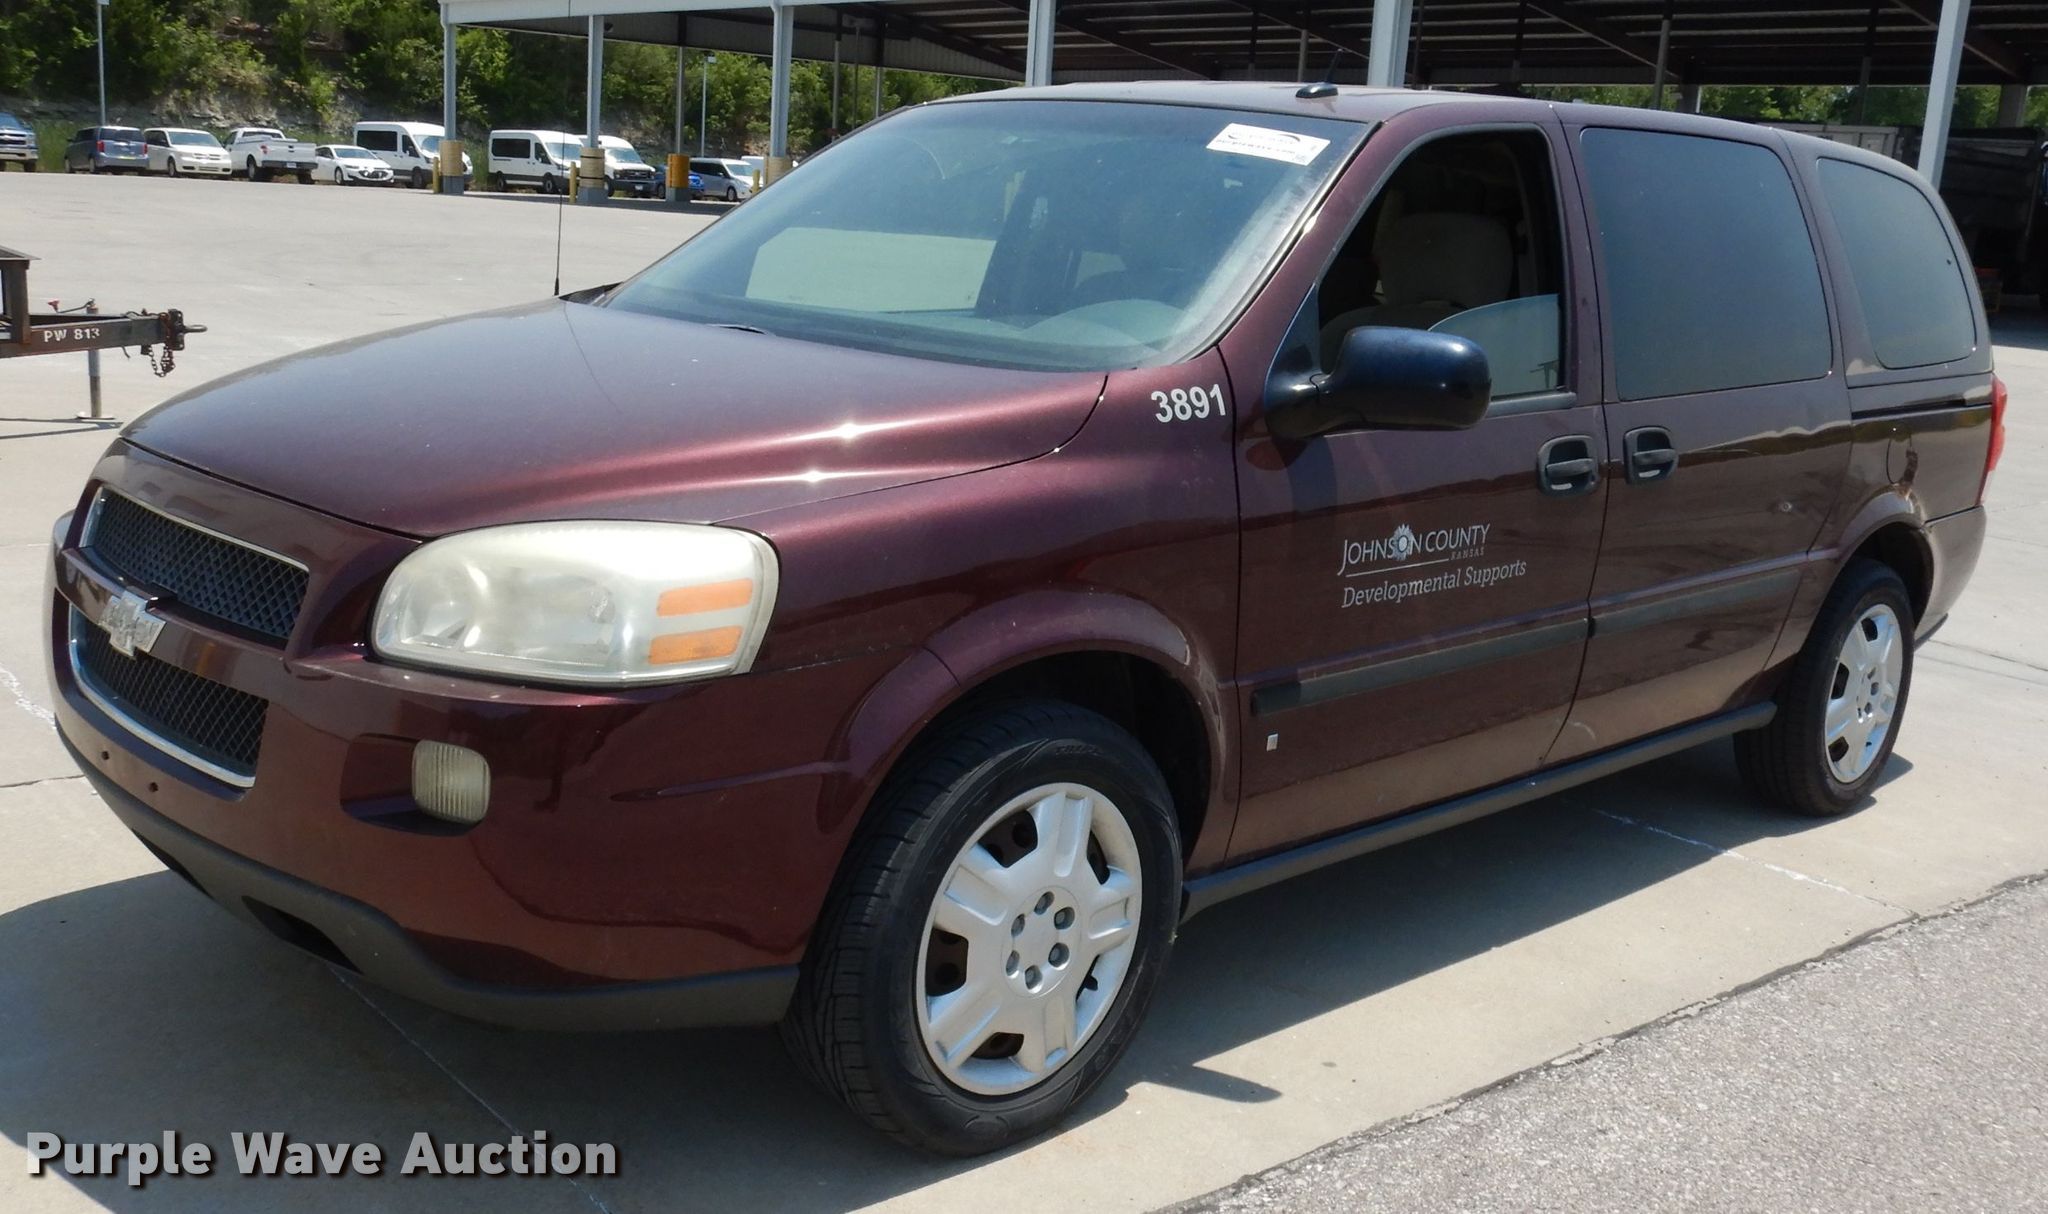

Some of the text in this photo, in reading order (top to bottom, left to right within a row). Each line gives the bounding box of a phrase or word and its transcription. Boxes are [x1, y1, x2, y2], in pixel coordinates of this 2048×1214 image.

[44, 329, 67, 342] PW
[1150, 383, 1226, 423] 3891
[1337, 523, 1490, 576] JOHNSON COUNTY
[1341, 560, 1527, 608] Developmental Supports
